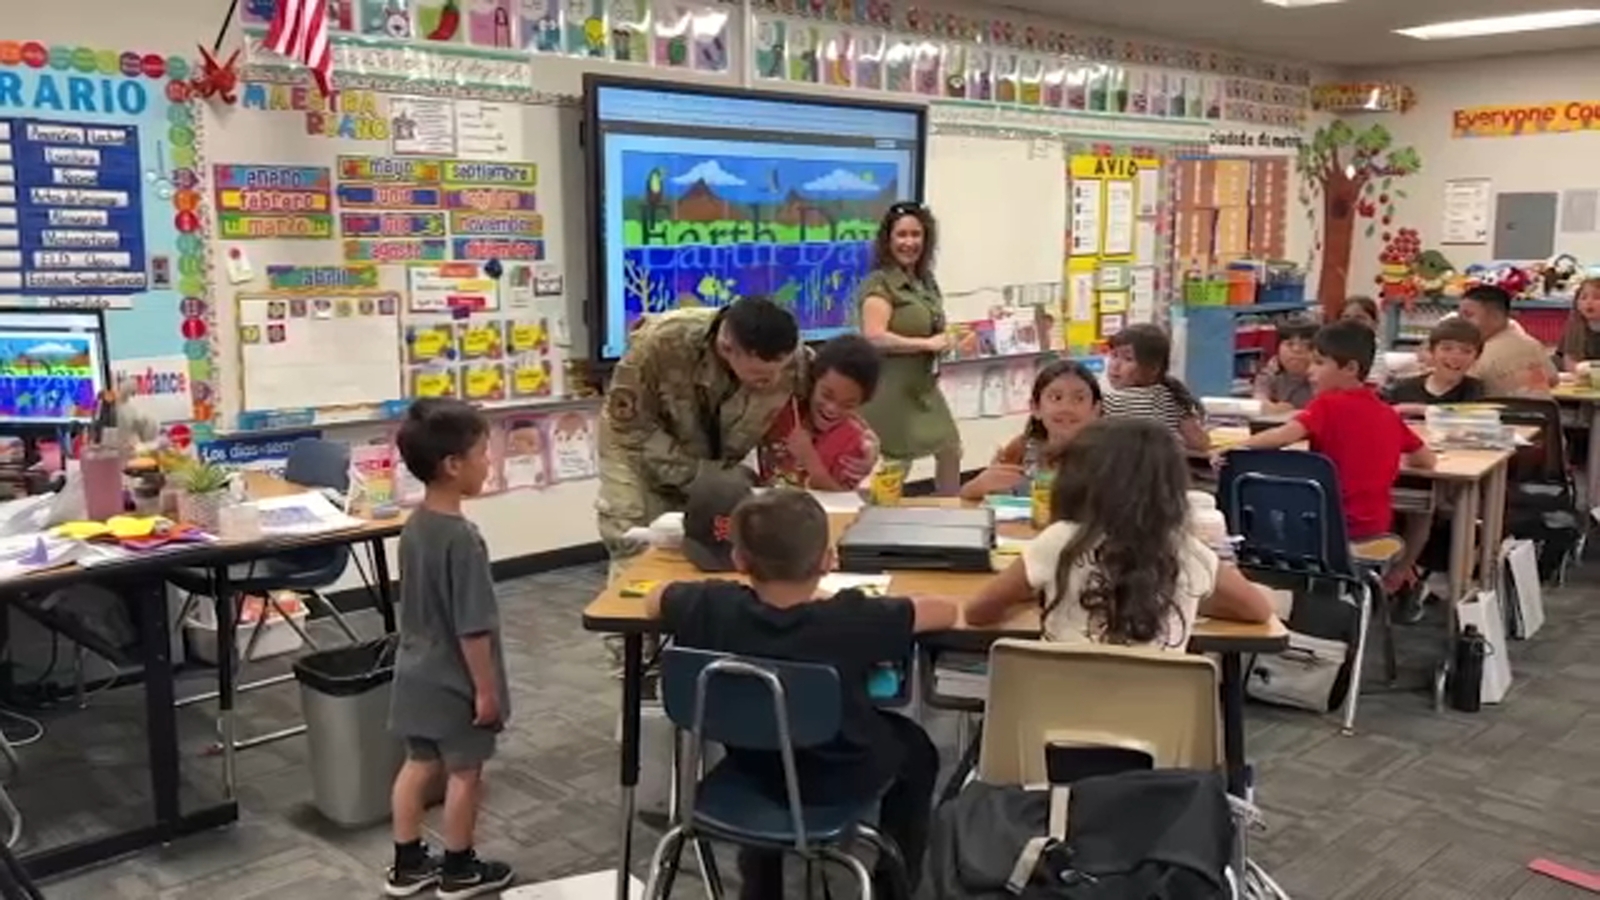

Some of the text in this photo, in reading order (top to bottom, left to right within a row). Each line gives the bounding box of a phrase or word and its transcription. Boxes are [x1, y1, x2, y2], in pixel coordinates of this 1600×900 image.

[1453, 106, 1556, 130] Everyone
[1094, 158, 1138, 176] AVID
[246, 168, 302, 187] enero
[240, 189, 314, 211] febrero
[247, 215, 309, 233] marzo
